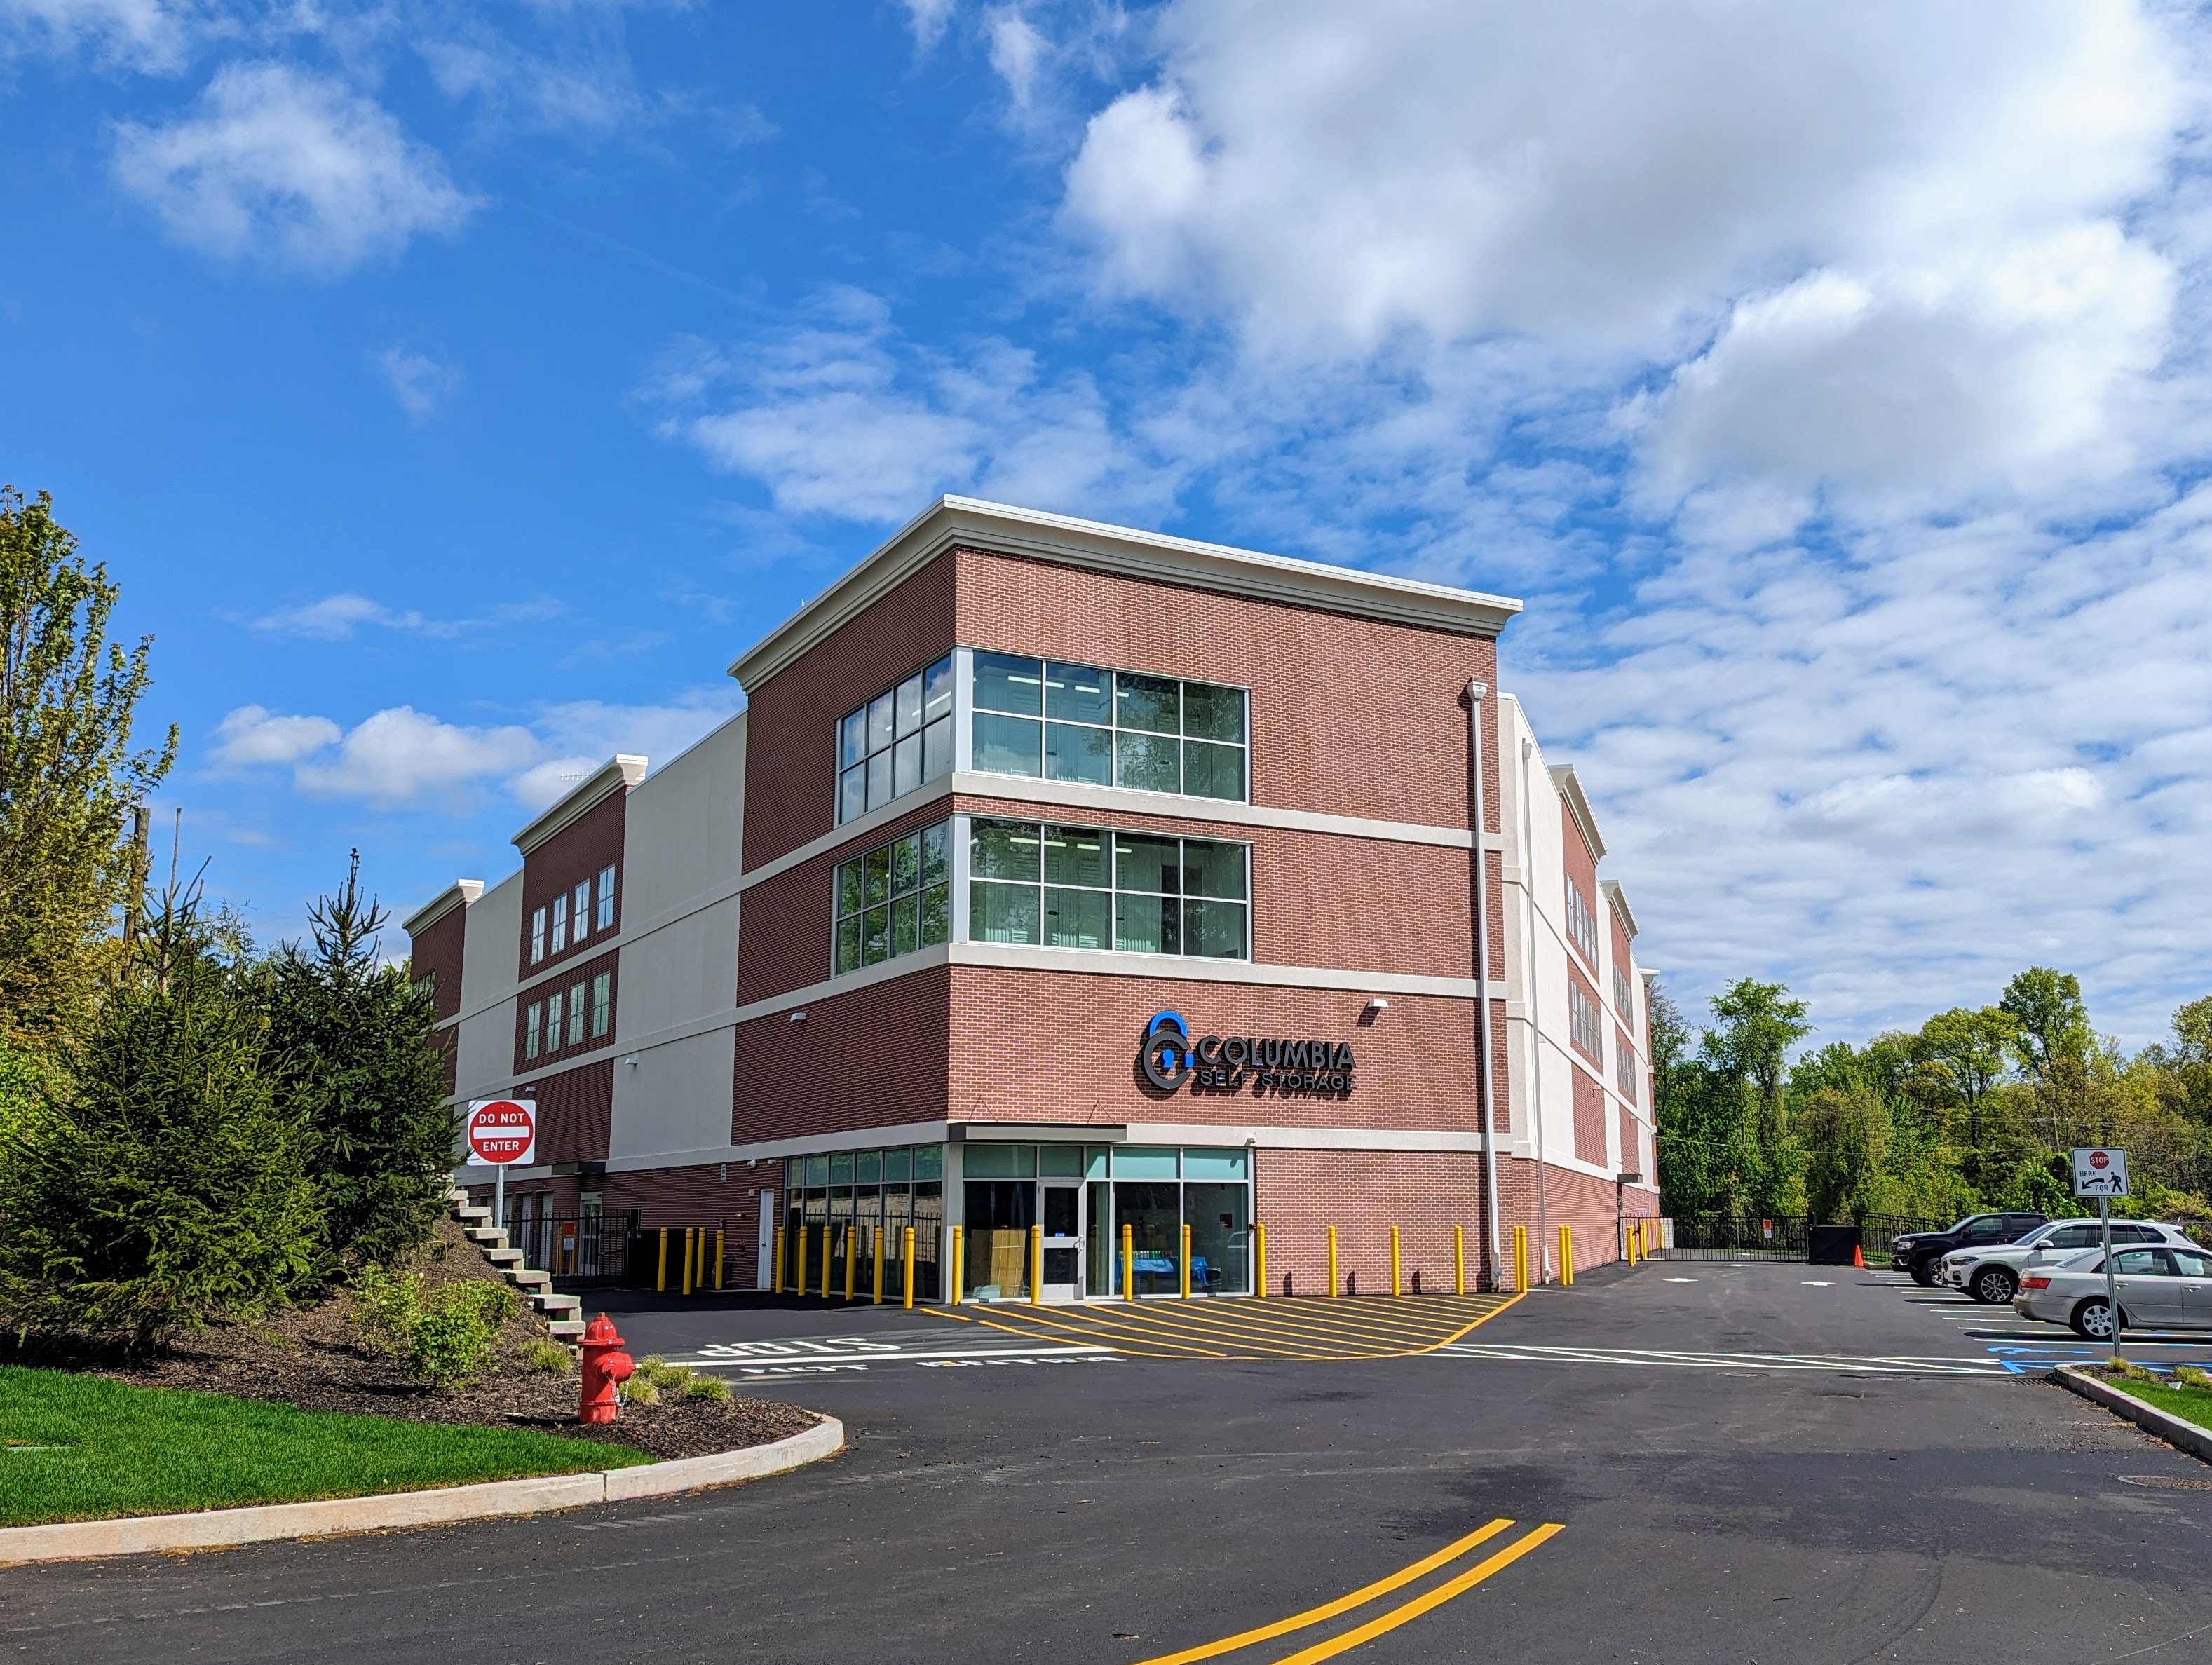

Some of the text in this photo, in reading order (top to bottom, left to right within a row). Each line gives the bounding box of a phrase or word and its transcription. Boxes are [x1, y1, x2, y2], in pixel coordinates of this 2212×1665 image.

[1200, 1036, 1356, 1069] COLUMBIA
[1200, 1070, 1357, 1090] SELF STORAGE
[480, 1113, 524, 1123] DO NOT
[483, 1141, 520, 1151] ENTER
[696, 1338, 901, 1357] STOP
